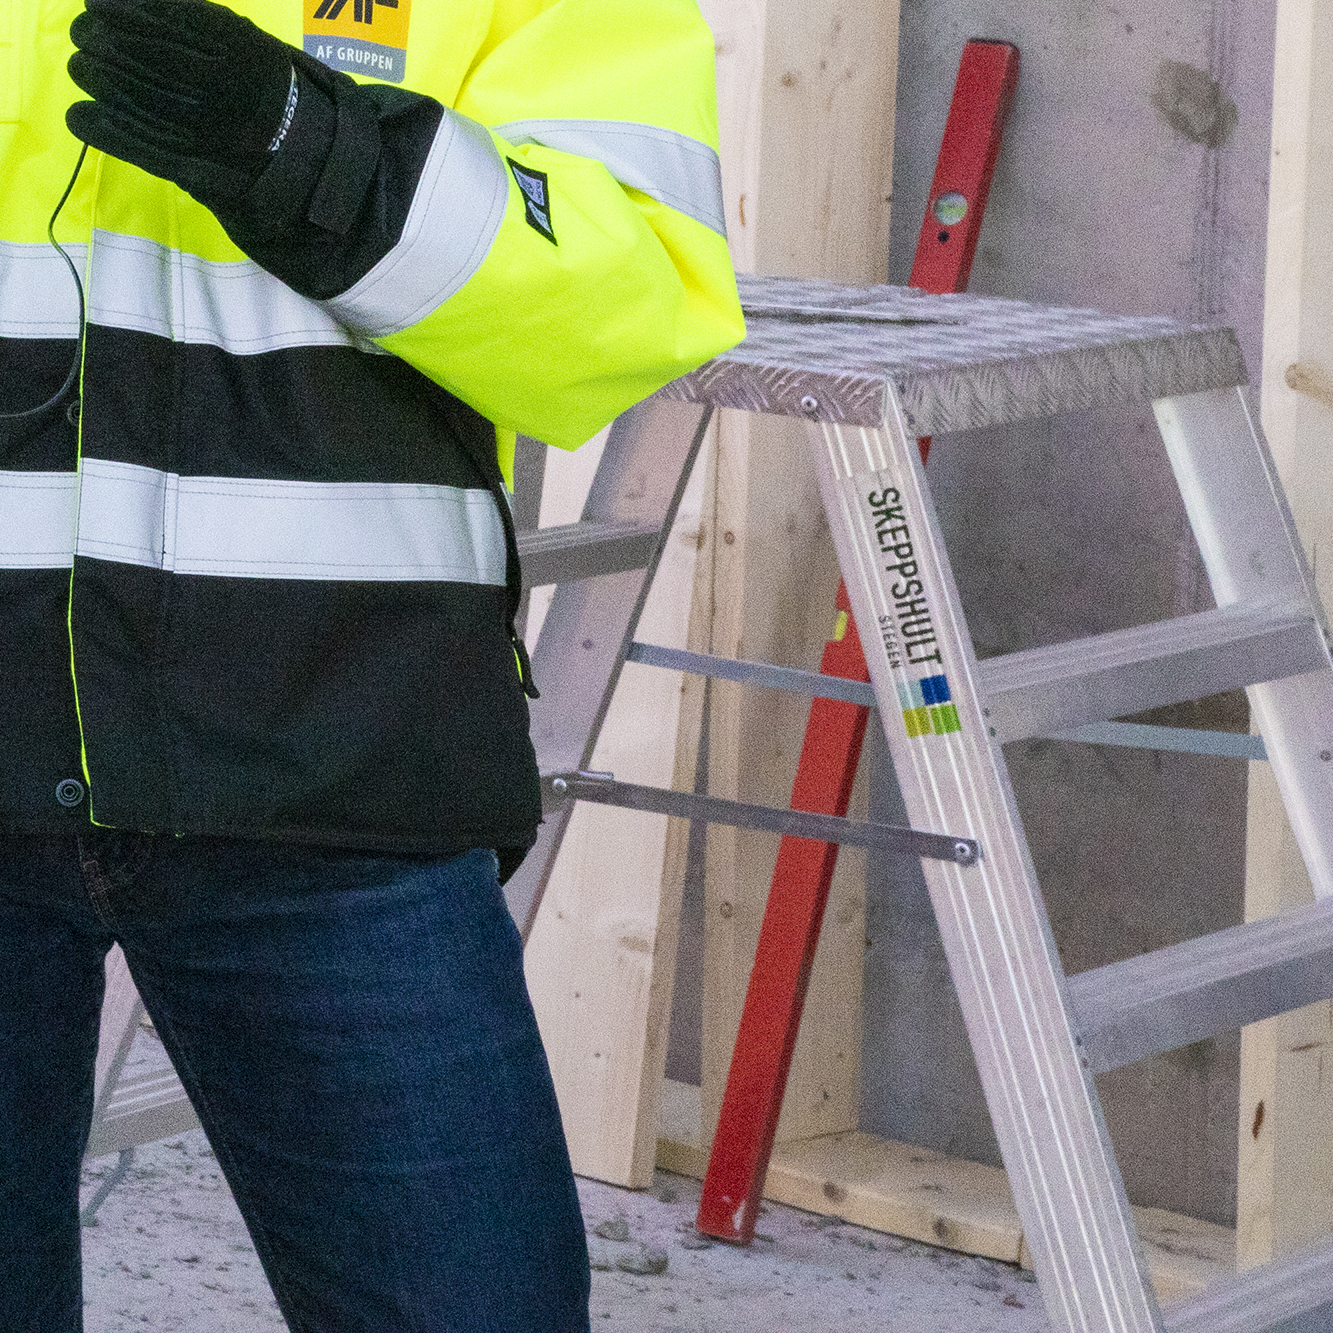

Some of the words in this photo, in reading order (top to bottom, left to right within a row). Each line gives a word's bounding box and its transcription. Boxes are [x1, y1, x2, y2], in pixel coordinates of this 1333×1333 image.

[316, 45, 333, 59] AF
[337, 47, 393, 71] GRUPPEN
[868, 487, 943, 665] SKEPPSHULT
[878, 616, 901, 670] STEGEN
